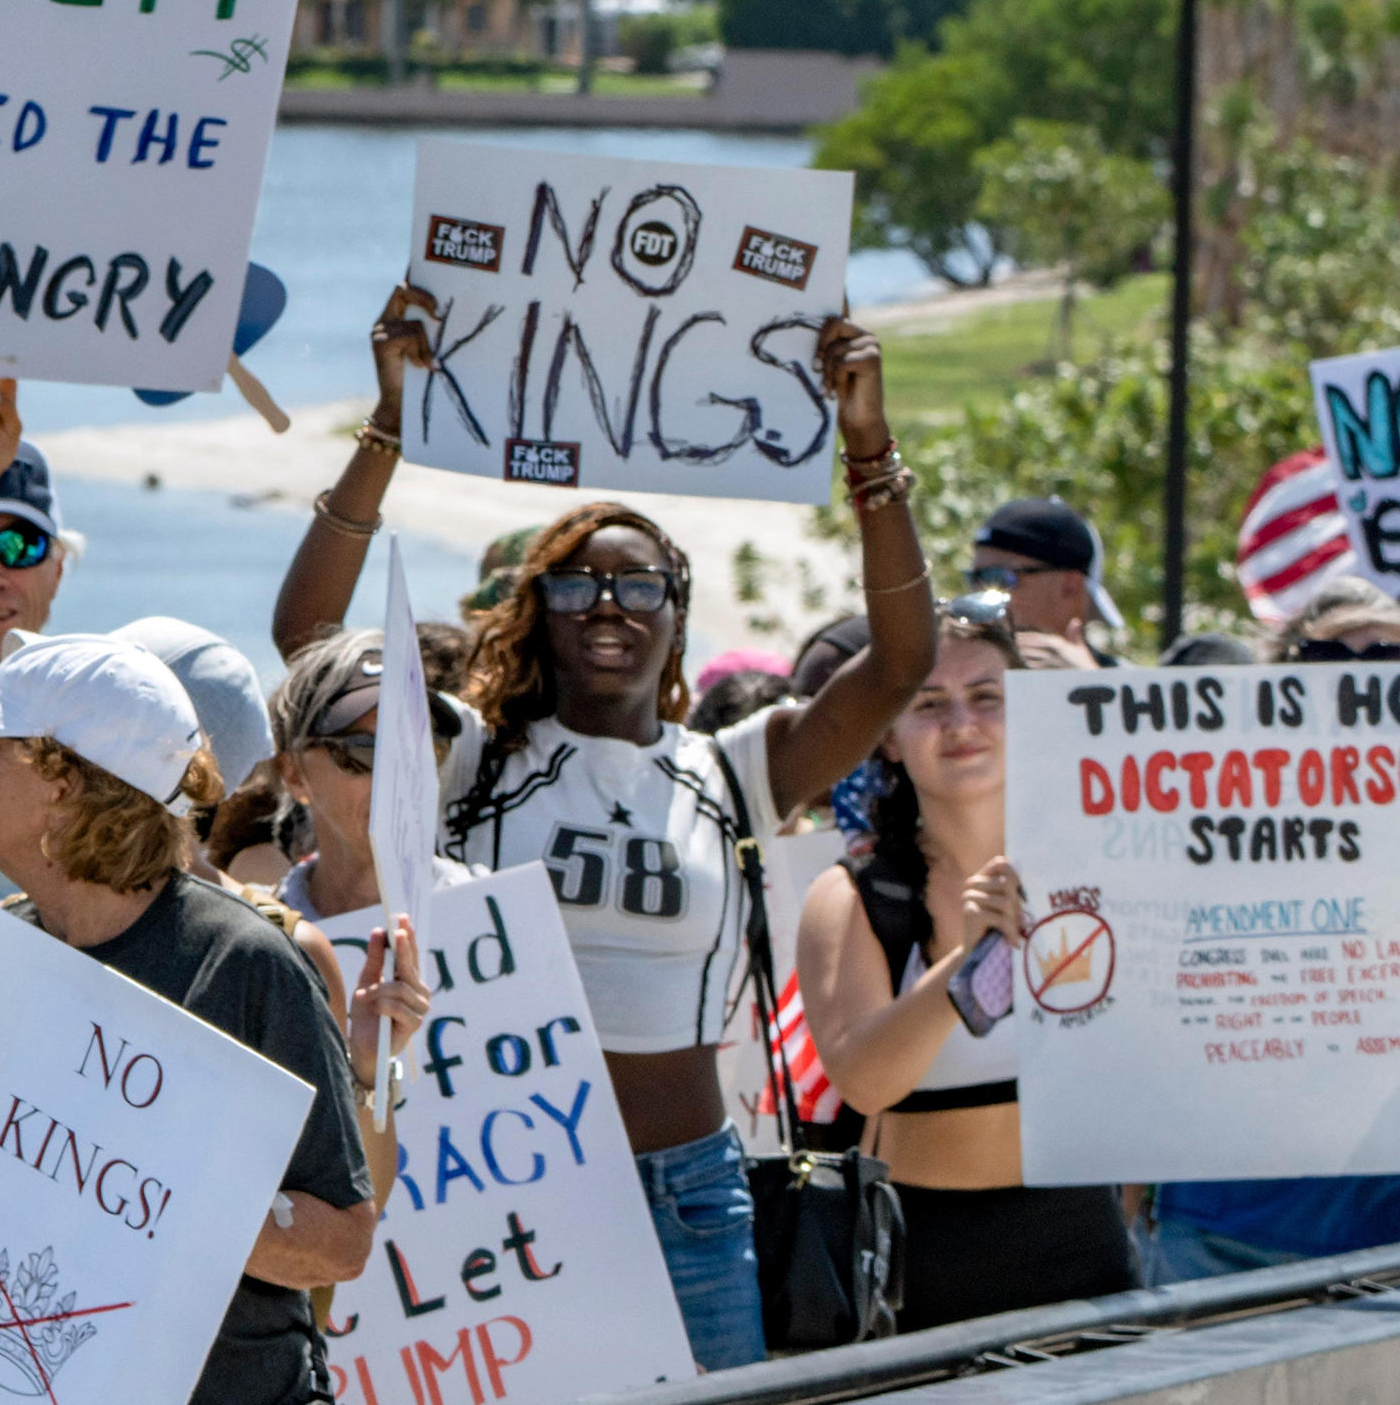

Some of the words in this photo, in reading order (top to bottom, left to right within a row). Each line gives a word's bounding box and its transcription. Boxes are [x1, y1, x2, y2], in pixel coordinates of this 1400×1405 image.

[90, 105, 228, 169] THE
[433, 239, 496, 263] TRUMP
[521, 179, 702, 297] NO
[633, 230, 674, 257] FDT
[742, 249, 805, 280] TRUMP
[422, 298, 830, 467] KINGS
[1325, 370, 1400, 480] N
[510, 461, 574, 482] TRUMP
[1068, 677, 1224, 735] THIS
[1257, 676, 1306, 728] IS
[1079, 745, 1400, 816] DICTATORS
[1186, 815, 1360, 864] STARTS
[545, 822, 688, 923] 58
[1185, 899, 1305, 934] AMENDMENT
[1312, 897, 1365, 932] ONE
[1376, 939, 1400, 960] LA
[75, 1021, 164, 1108] NO
[423, 1015, 582, 1098] for
[1204, 1037, 1304, 1064] PEACEABLY
[385, 1211, 563, 1318] Let
